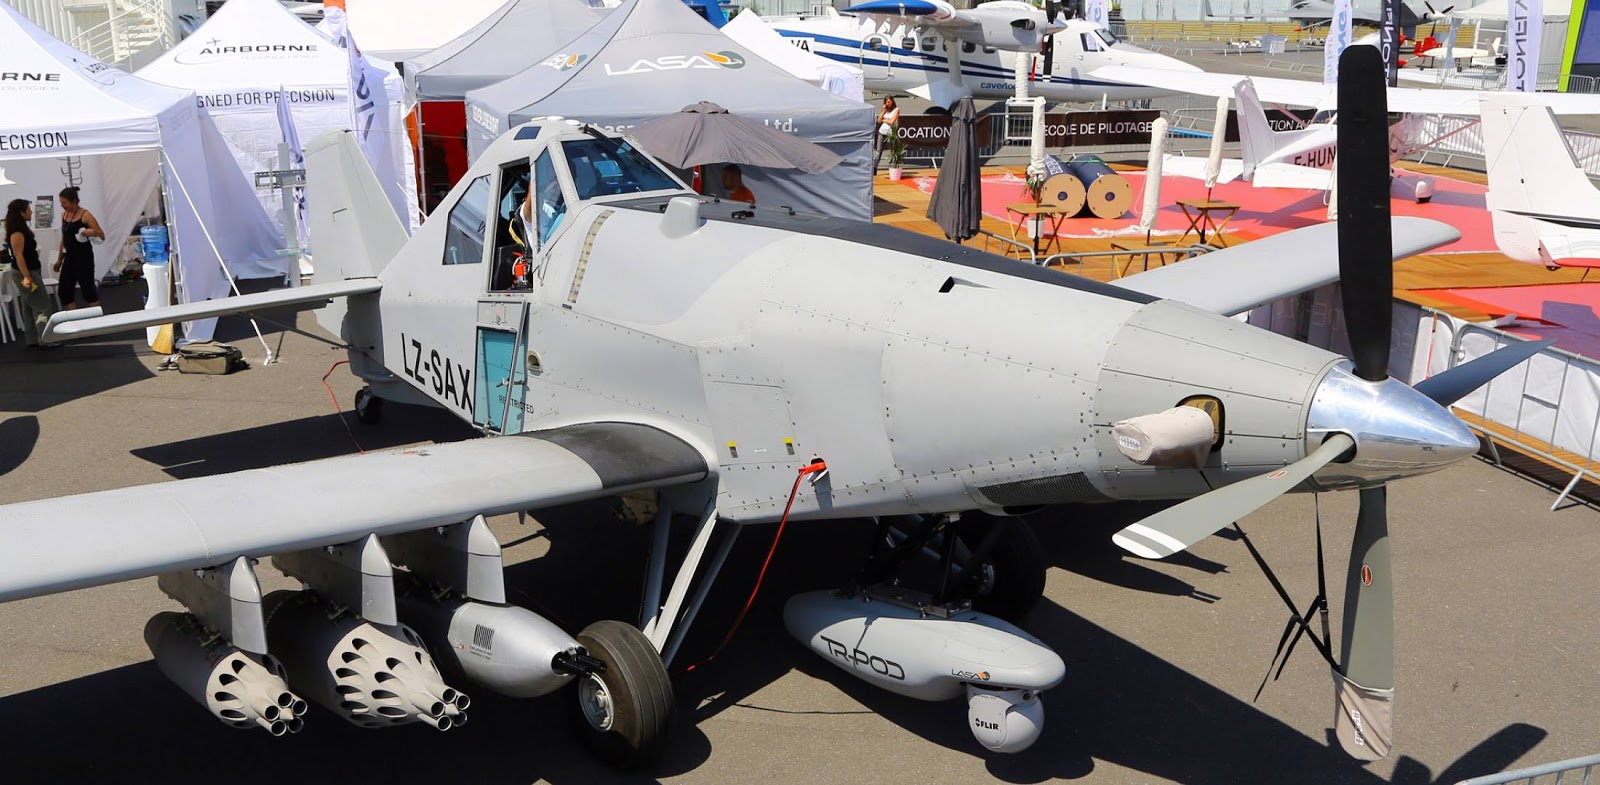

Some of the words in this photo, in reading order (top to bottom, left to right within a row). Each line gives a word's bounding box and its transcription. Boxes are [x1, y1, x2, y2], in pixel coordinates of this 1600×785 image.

[200, 44, 318, 55] AIRBORNE
[604, 55, 721, 76] LASA
[236, 91, 262, 106] FOR
[1080, 122, 1096, 135] DE
[1098, 120, 1152, 134] PILOTAGE
[0, 131, 69, 151] ECISION
[401, 332, 473, 415] LZ-SAX
[498, 394, 535, 414] RETRICTED
[820, 634, 906, 681] TR-POD
[951, 668, 982, 680] LASA
[980, 720, 999, 731] FLIR
